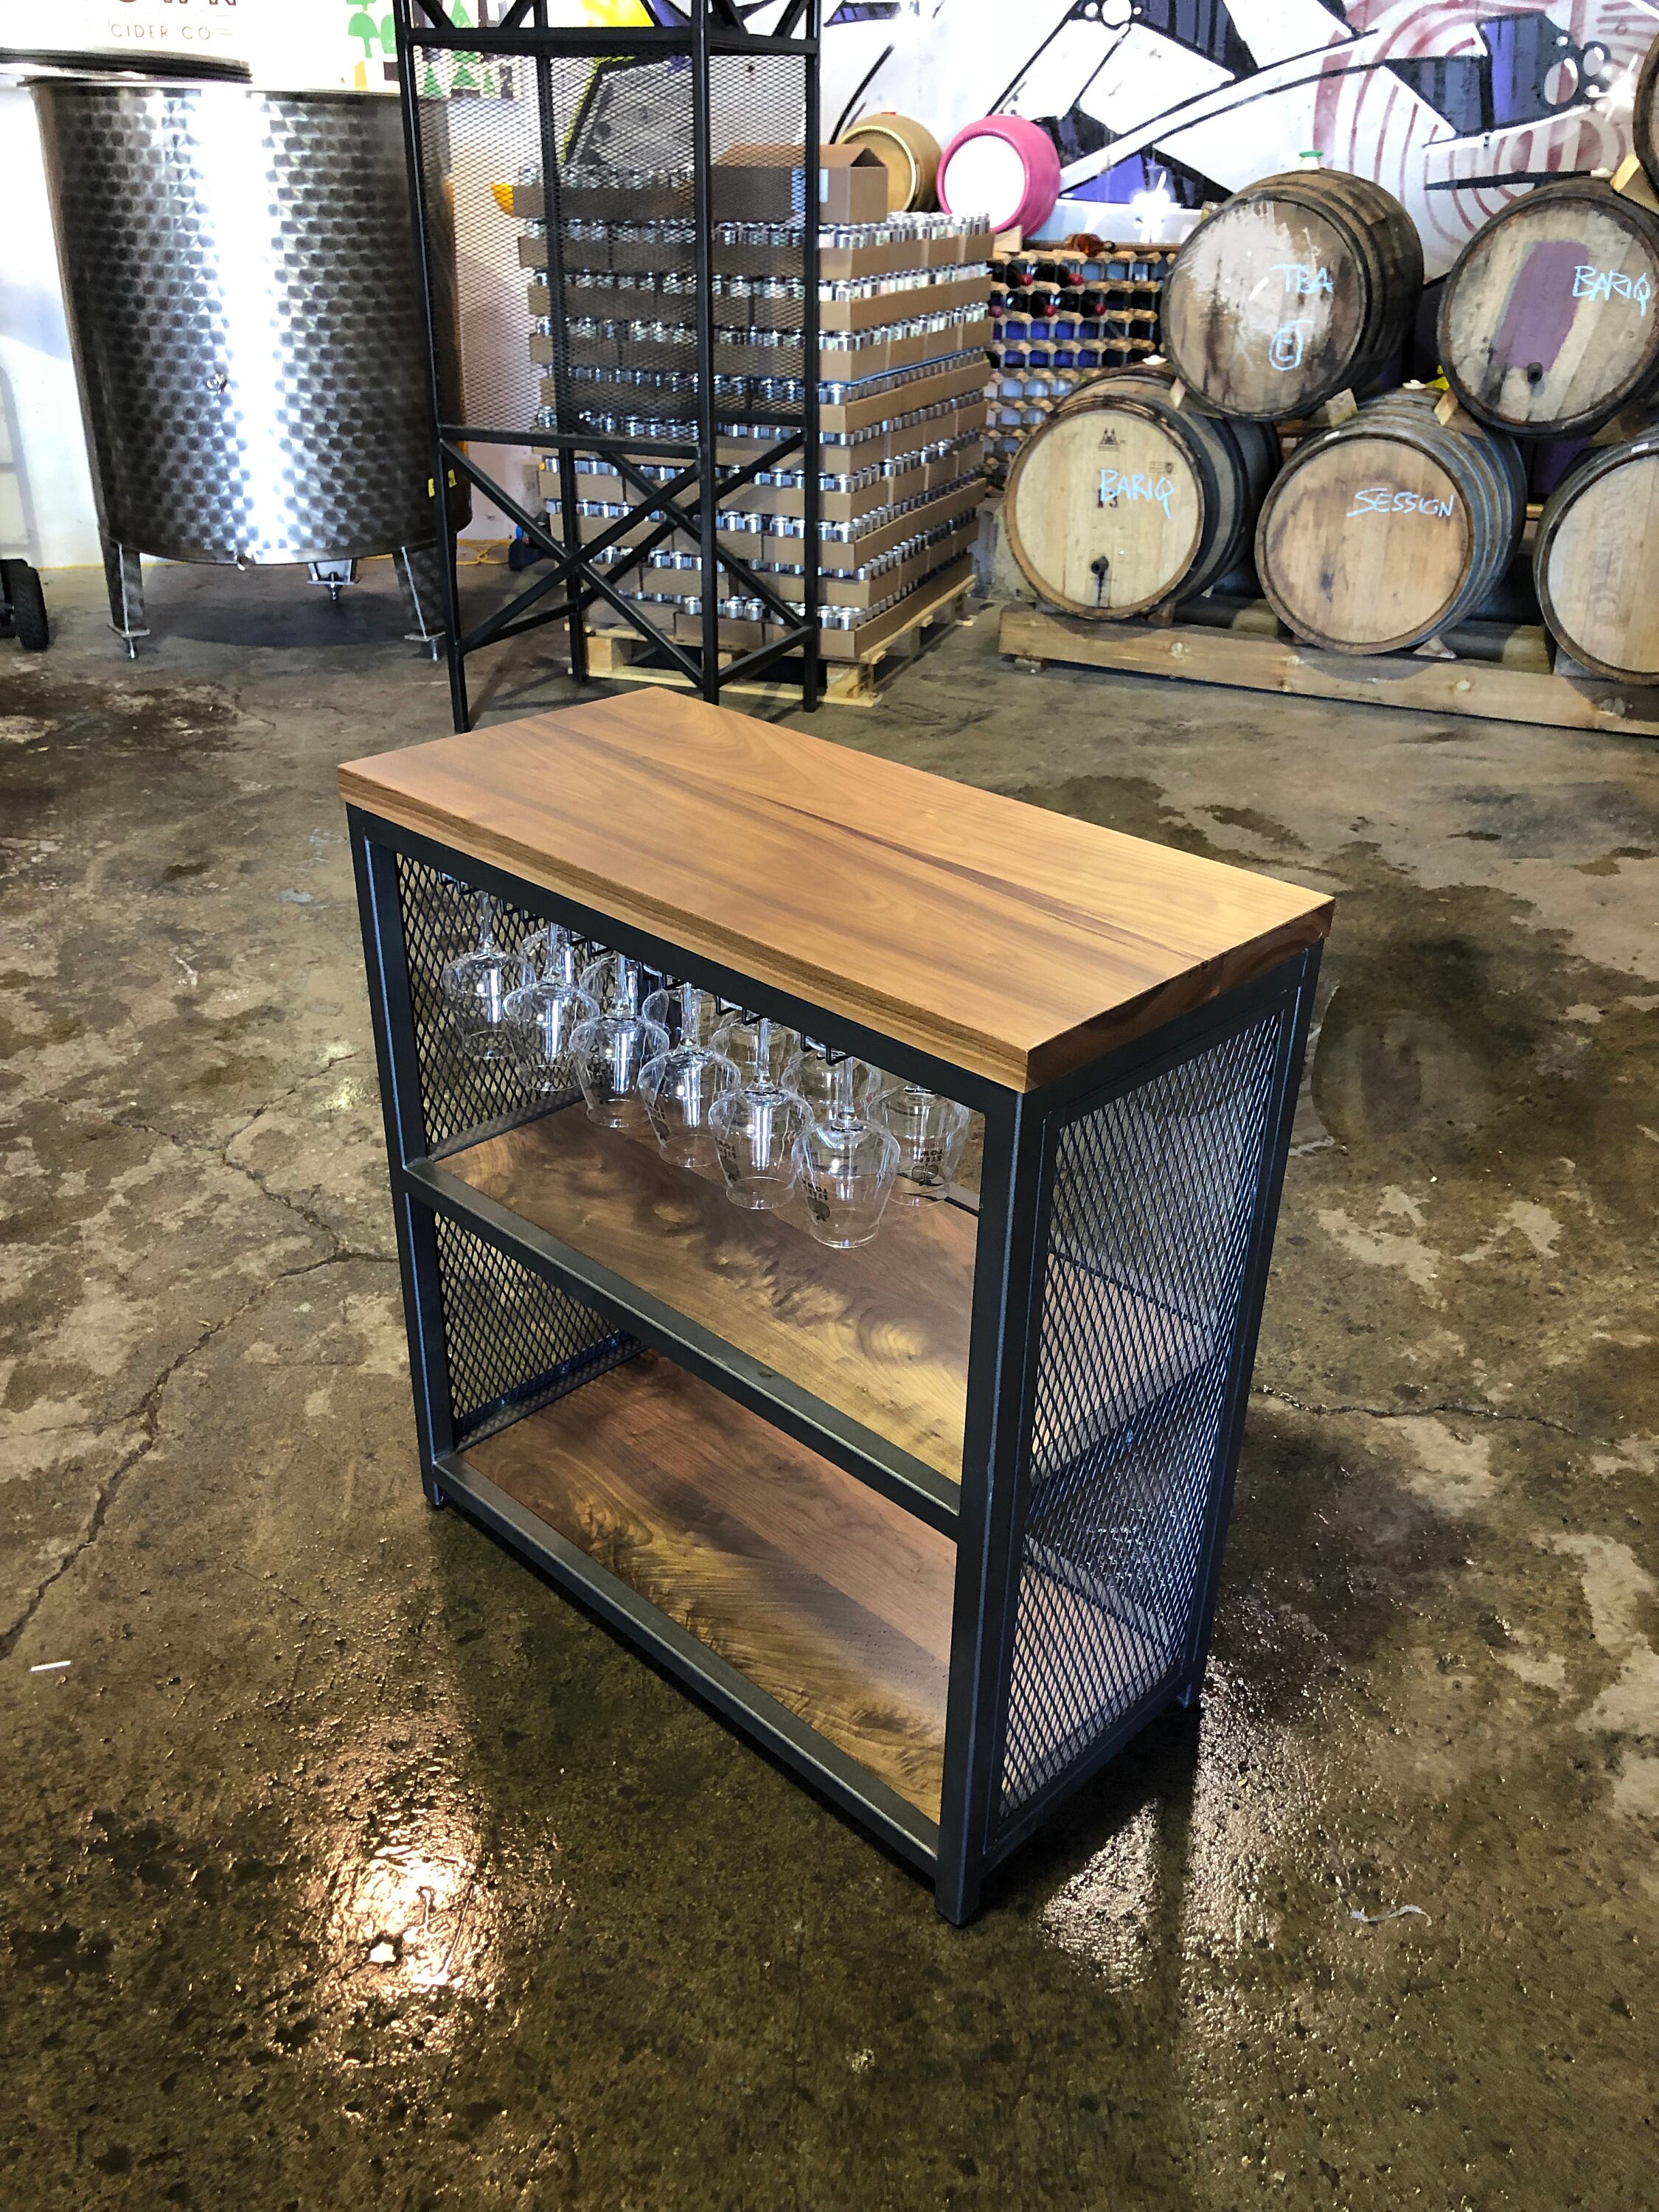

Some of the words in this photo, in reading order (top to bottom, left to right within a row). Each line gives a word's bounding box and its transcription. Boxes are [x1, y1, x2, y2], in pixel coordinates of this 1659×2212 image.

[110, 23, 168, 38] CIDER
[181, 26, 211, 41] CO
[1269, 263, 1334, 293] TBA
[1099, 468, 1175, 519] BARIQ
[1346, 487, 1454, 518] SESSION
